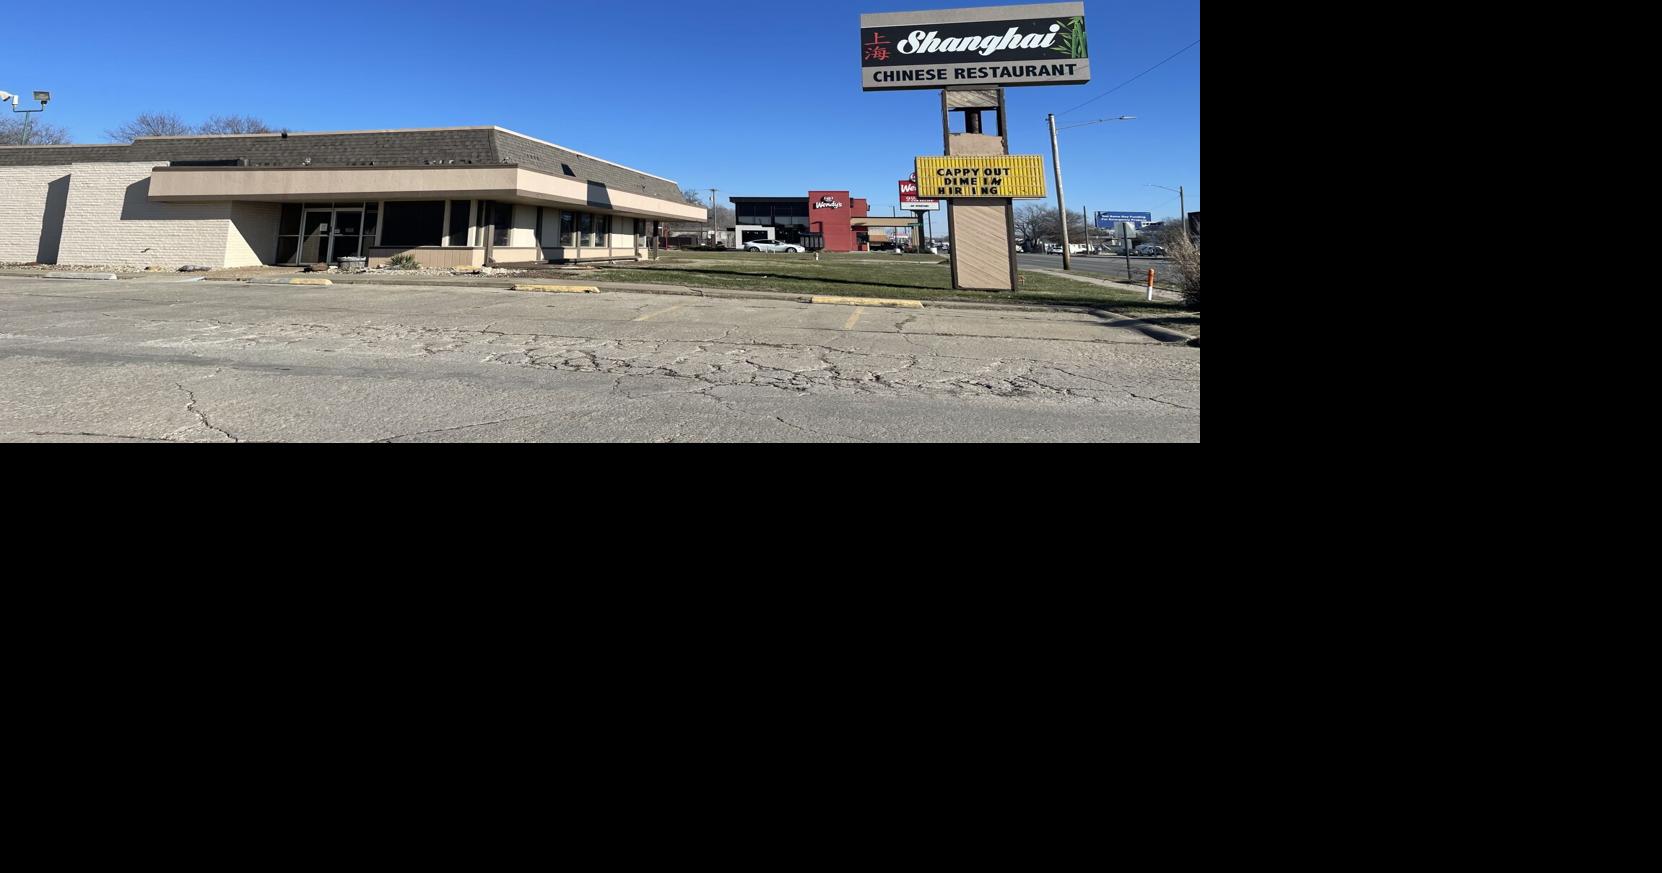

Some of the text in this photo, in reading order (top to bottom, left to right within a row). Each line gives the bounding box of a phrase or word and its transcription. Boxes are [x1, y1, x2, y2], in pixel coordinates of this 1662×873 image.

[864, 32, 892, 61] 上海
[897, 24, 1061, 56] Shanghai
[873, 63, 1077, 82] CHINESE RESTAURANT
[984, 168, 1010, 176] OUT
